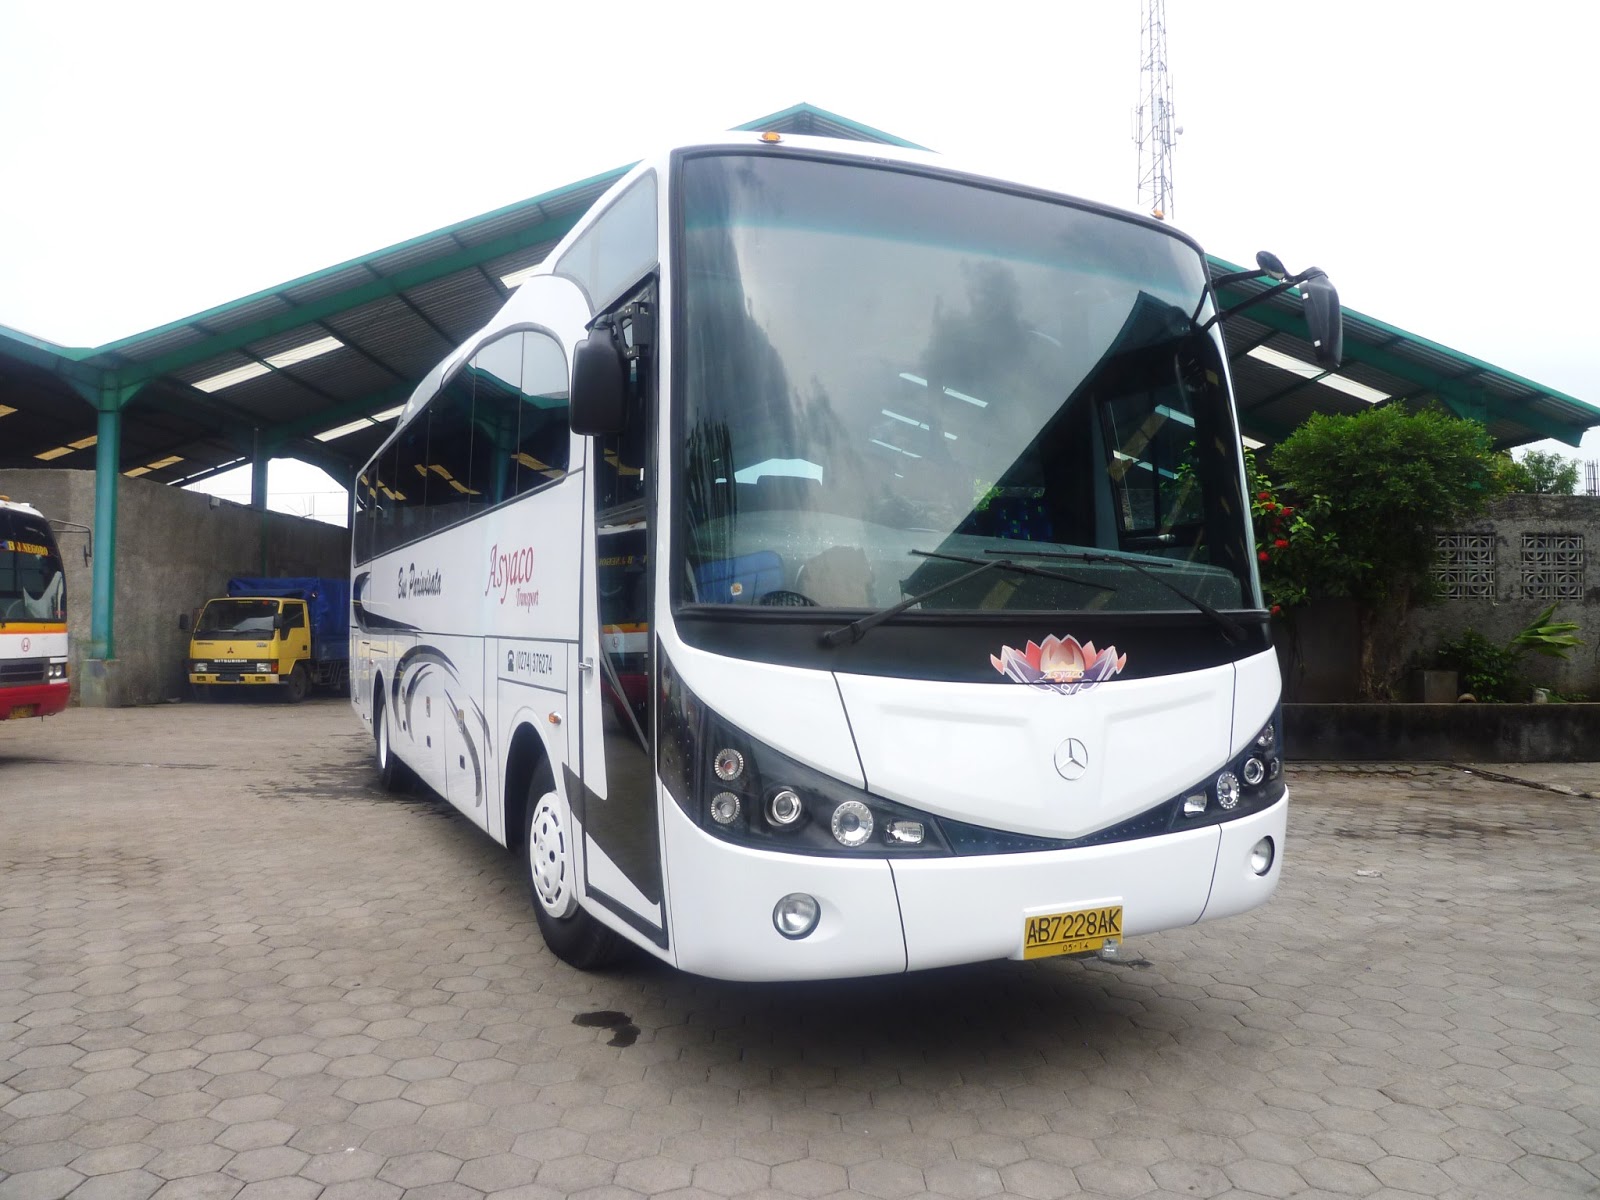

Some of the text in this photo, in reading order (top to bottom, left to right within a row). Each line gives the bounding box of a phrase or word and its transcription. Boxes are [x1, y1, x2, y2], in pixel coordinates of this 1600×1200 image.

[484, 543, 534, 605] Asyaco
[515, 587, 539, 613] Transport
[532, 652, 552, 675] 376274
